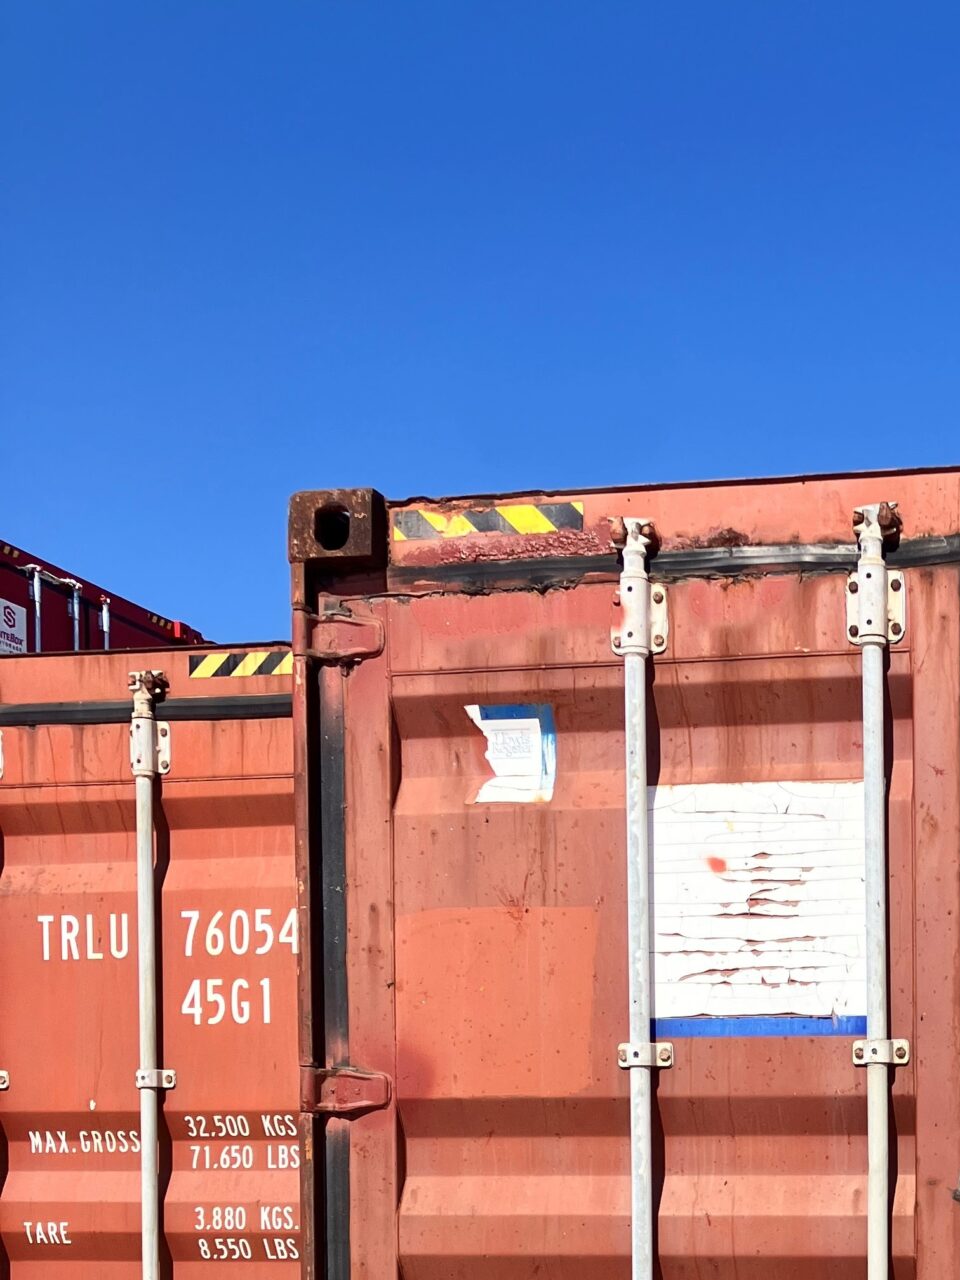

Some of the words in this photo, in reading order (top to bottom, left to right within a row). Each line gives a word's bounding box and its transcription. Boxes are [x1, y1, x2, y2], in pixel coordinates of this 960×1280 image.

[37, 913, 129, 961] TRLU
[180, 907, 299, 956] 76054
[181, 977, 271, 1025] 45G1
[184, 1115, 250, 1137] 32,500
[261, 1114, 297, 1137] KGS
[190, 1145, 254, 1169] 71,650
[267, 1144, 300, 1169] LBS
[23, 1221, 72, 1244] TARE
[263, 1238, 299, 1260] LBS
